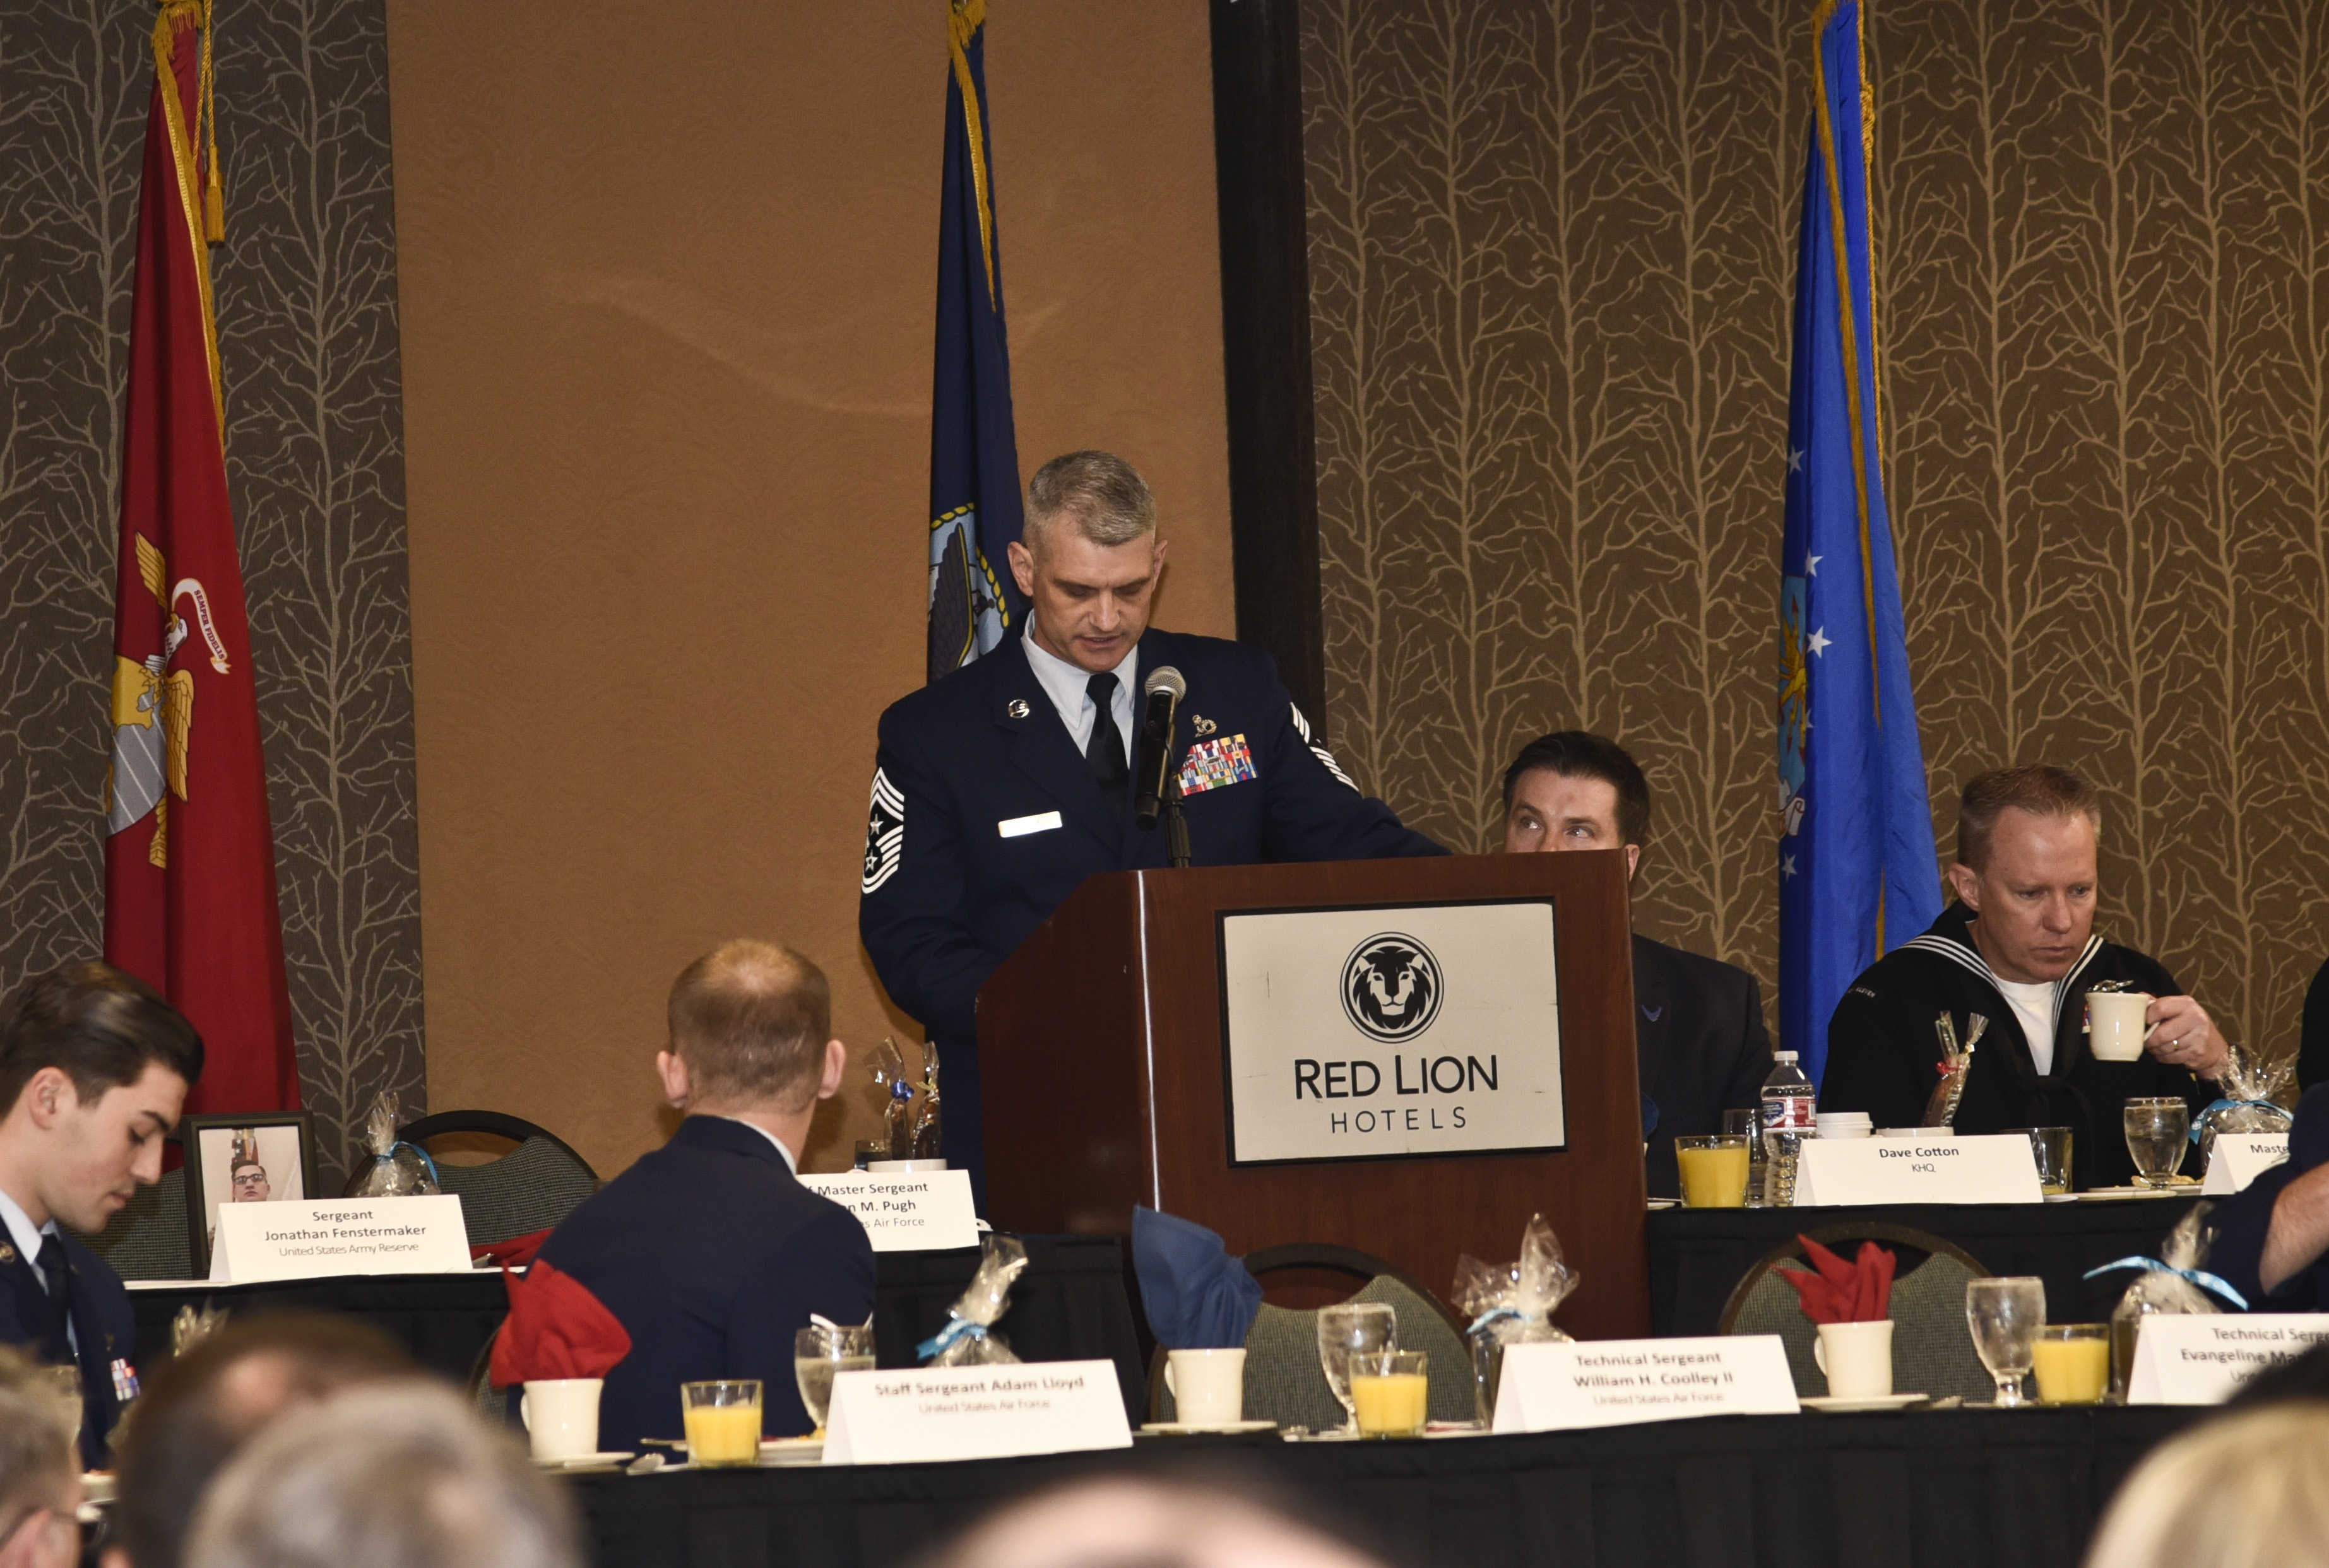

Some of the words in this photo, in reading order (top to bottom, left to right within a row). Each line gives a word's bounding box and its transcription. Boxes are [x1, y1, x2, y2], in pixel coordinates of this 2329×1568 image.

[194, 589, 210, 626] SEMPER
[204, 626, 225, 660] FIDELIS
[1295, 1058, 1382, 1100] RED
[1395, 1054, 1498, 1095] LION
[1331, 1106, 1466, 1134] HOTELS
[1879, 1148, 1912, 1158] Dave
[1916, 1147, 1960, 1157] Cotton
[1911, 1163, 1936, 1173] KHQ
[817, 1185, 865, 1196] Master
[869, 1182, 928, 1195] Sergeant
[860, 1201, 879, 1212] M.
[883, 1200, 916, 1213] Pugh
[312, 1210, 374, 1223] Sergeant
[874, 1218, 889, 1228] Air
[893, 1217, 925, 1227] Force
[265, 1229, 328, 1241] Jonathan
[333, 1225, 427, 1239] Fenstermaker
[279, 1246, 314, 1257] United
[316, 1245, 347, 1255] States
[348, 1244, 377, 1254] Army
[379, 1243, 420, 1253] Reserve
[2213, 1328, 2284, 1340] Technical
[1575, 1353, 1648, 1367] Technical
[1652, 1352, 1722, 1366] Sergeant
[2181, 1348, 2267, 1364] Evangeline
[875, 1382, 911, 1396] Staff
[916, 1381, 985, 1396] Sergeant
[991, 1378, 1038, 1392] Adam
[1041, 1375, 1084, 1391] Lloyd
[1573, 1372, 1634, 1388] William
[1661, 1372, 1719, 1386] Coolley
[1594, 1393, 1633, 1405] United
[1635, 1393, 1671, 1404] States
[1673, 1392, 1688, 1402] Air
[1692, 1391, 1724, 1401] Force
[918, 1402, 959, 1414] United
[961, 1401, 997, 1412] States
[999, 1400, 1013, 1410] Air
[1018, 1398, 1050, 1410] Force
